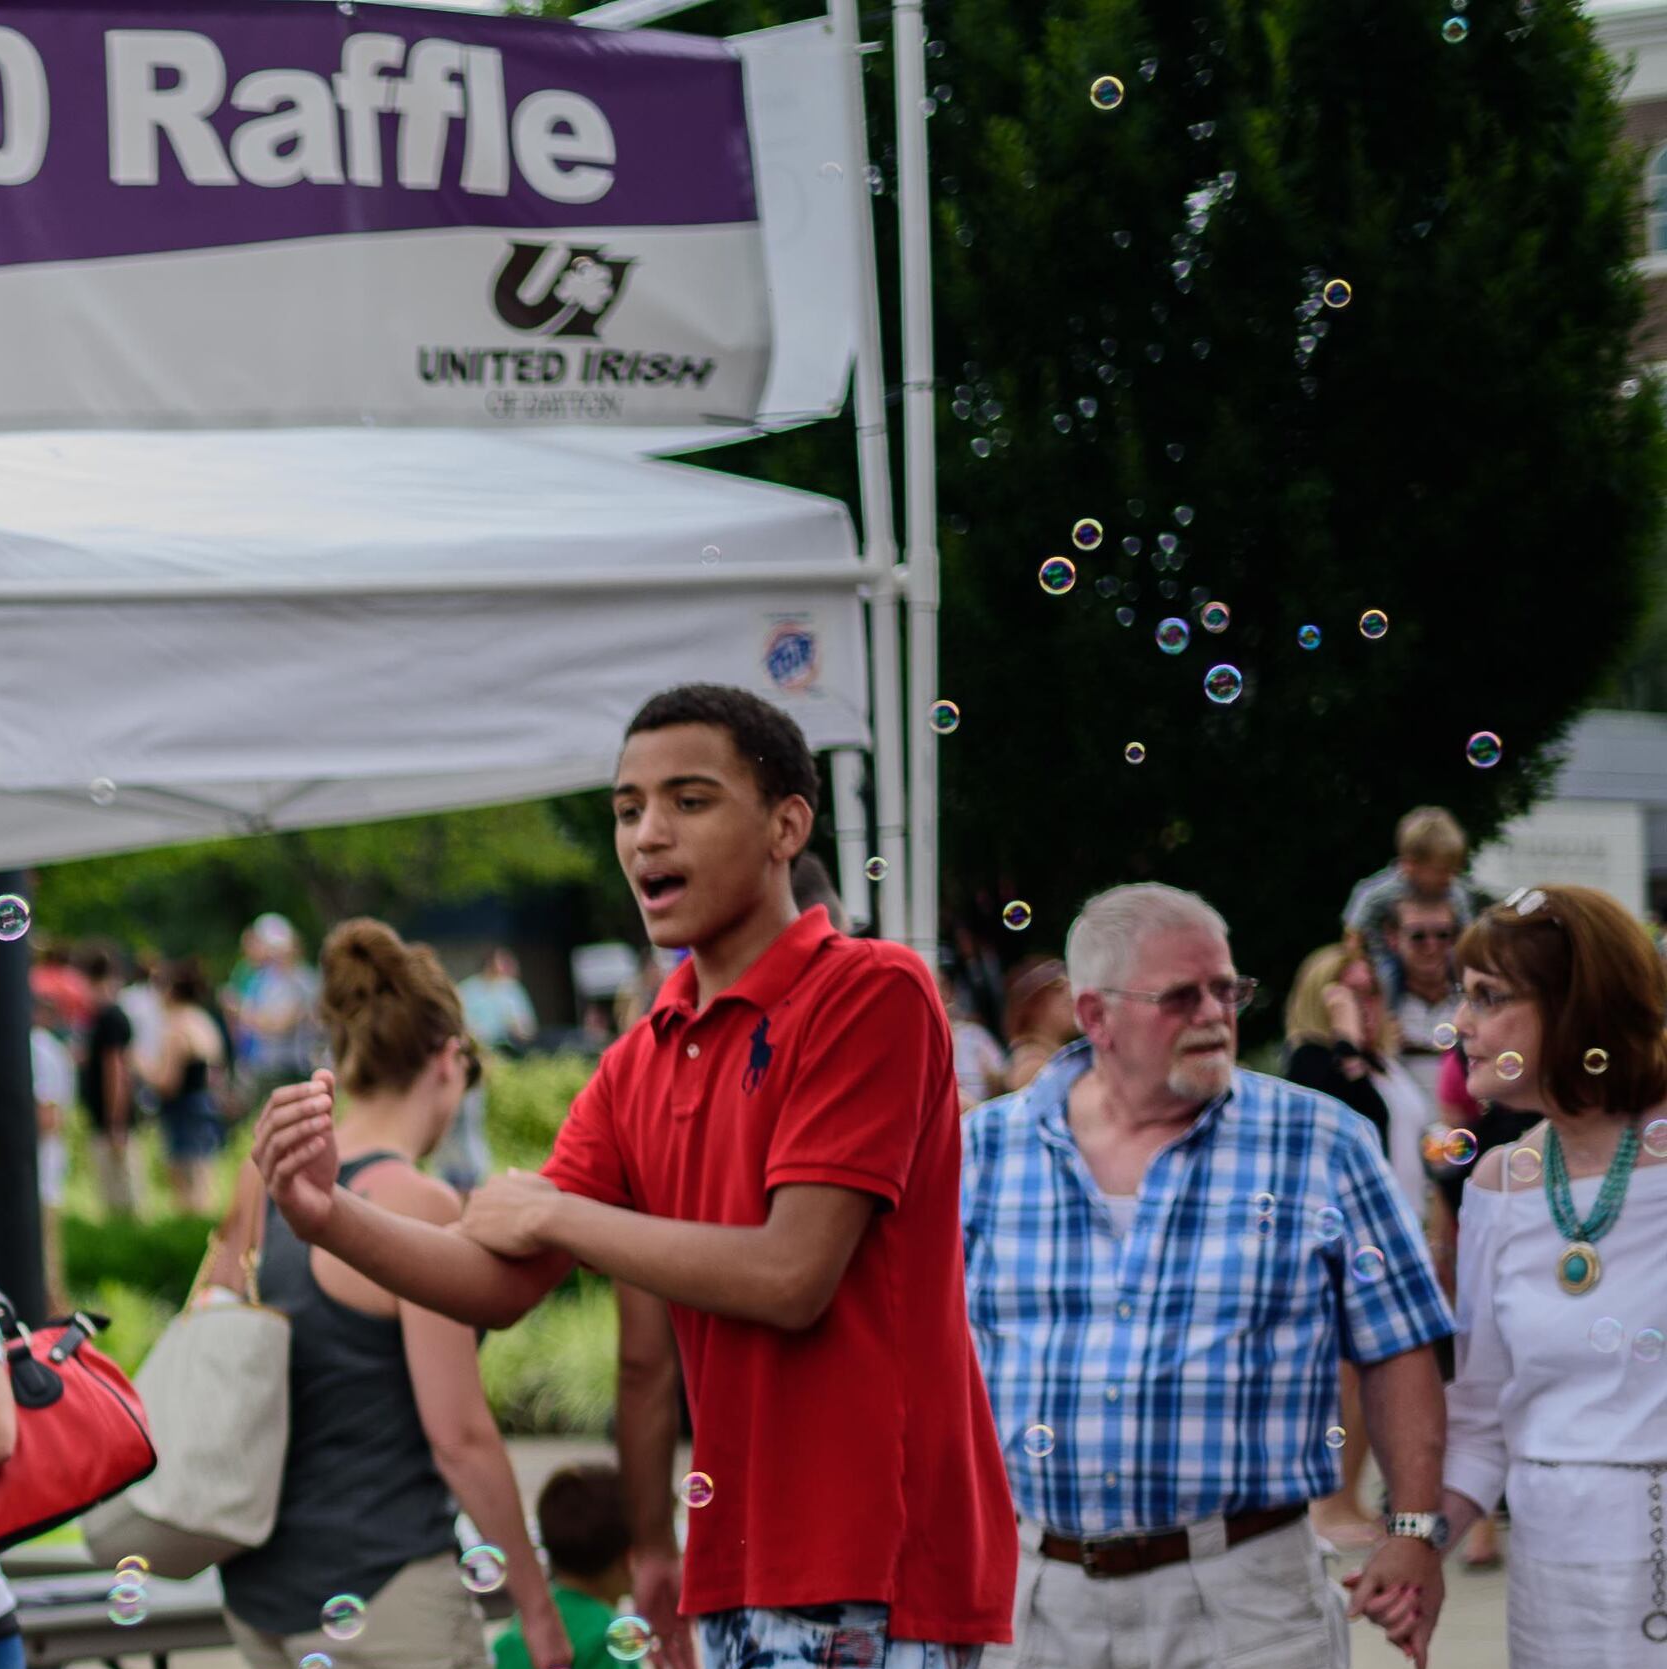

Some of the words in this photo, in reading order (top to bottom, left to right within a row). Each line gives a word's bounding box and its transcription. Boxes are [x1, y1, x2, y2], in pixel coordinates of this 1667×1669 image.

[104, 29, 617, 204] Raffle
[419, 348, 566, 385] UNITED
[579, 348, 718, 390] IRISH
